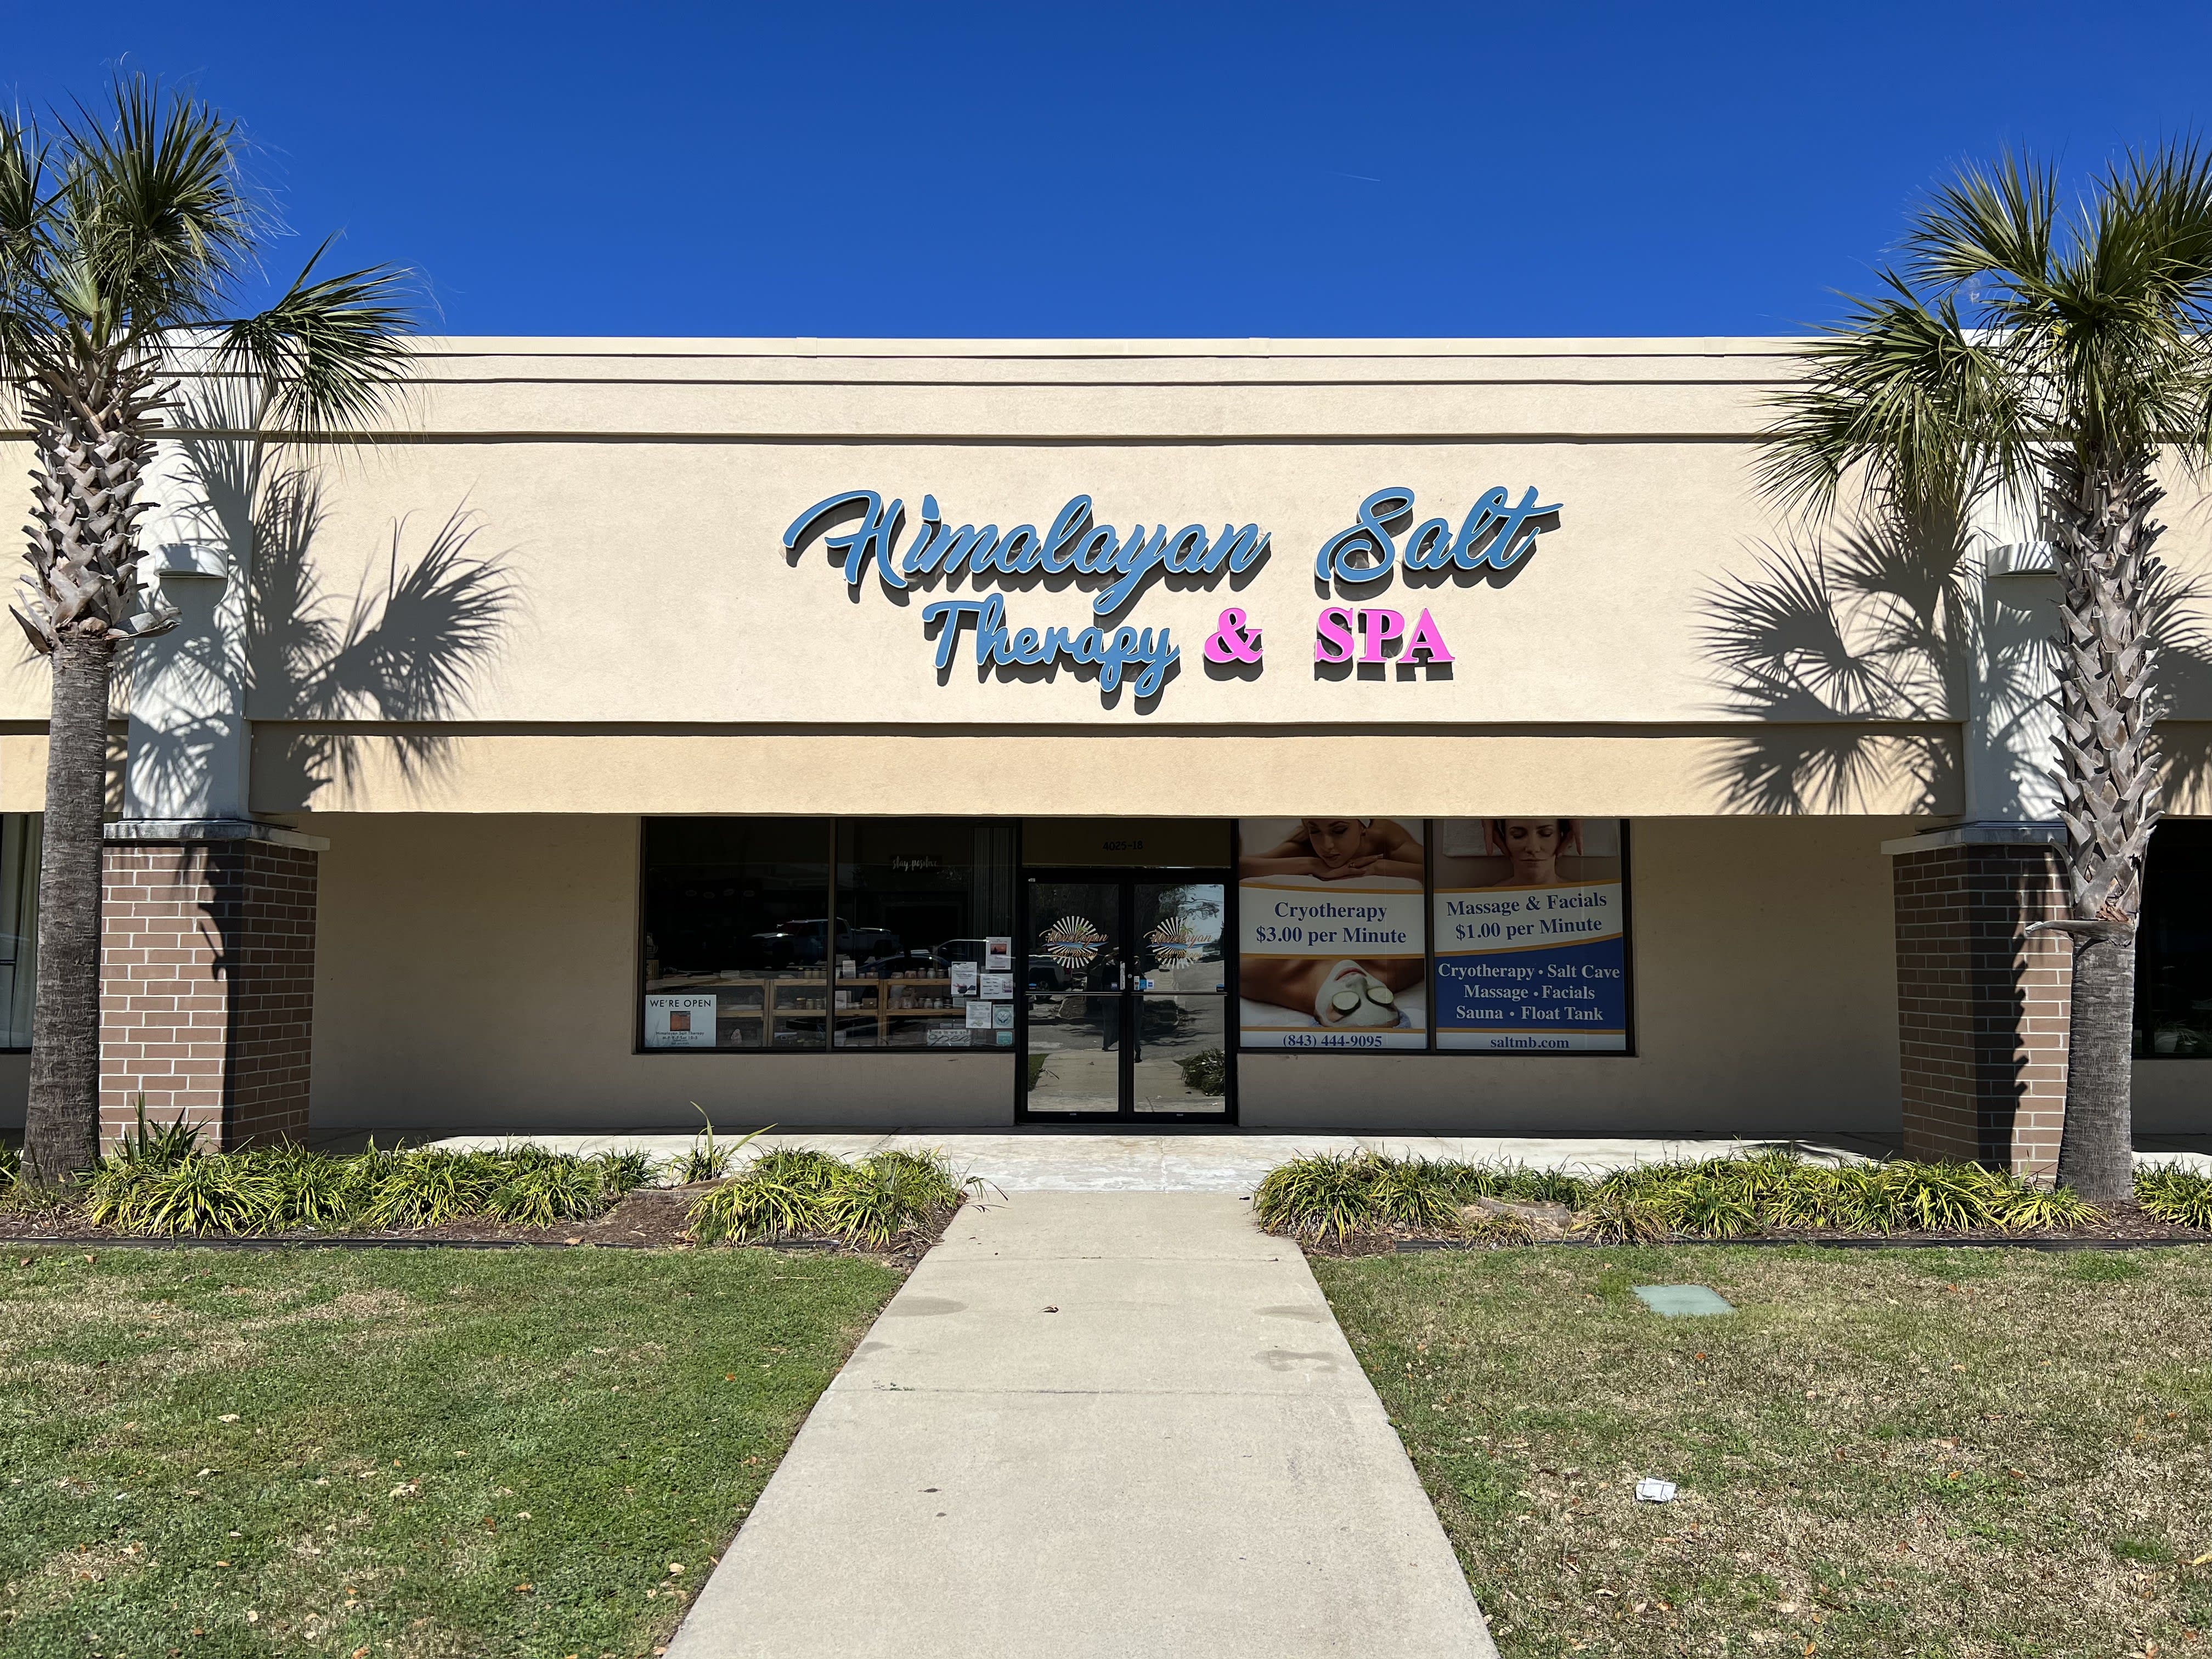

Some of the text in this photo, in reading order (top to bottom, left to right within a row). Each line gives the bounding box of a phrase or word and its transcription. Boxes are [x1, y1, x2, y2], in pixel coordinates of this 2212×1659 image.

[782, 486, 1564, 614] Himalayan Salt
[923, 593, 1455, 697] Therapy & SPA
[1102, 840, 1143, 851] 4025-18
[893, 855, 909, 872] stay
[1274, 901, 1387, 922] Cryotherapy
[1447, 892, 1607, 916] Massage & Facials
[1039, 928, 1109, 948] Himalayan
[1256, 925, 1407, 946] $3.00 per Minute
[1455, 918, 1602, 941] $1.00 per Minute
[1143, 929, 1212, 949] Himalayan
[1438, 963, 1621, 980] Cryotherapy Salt Cave
[1464, 985, 1595, 1002] Massage Facials
[1456, 1006, 1604, 1020] Sauna Float Tank
[929, 1035, 971, 1047] open
[1283, 1035, 1382, 1048] (843) 444-9095
[1490, 1037, 1570, 1049] saltmb.com
